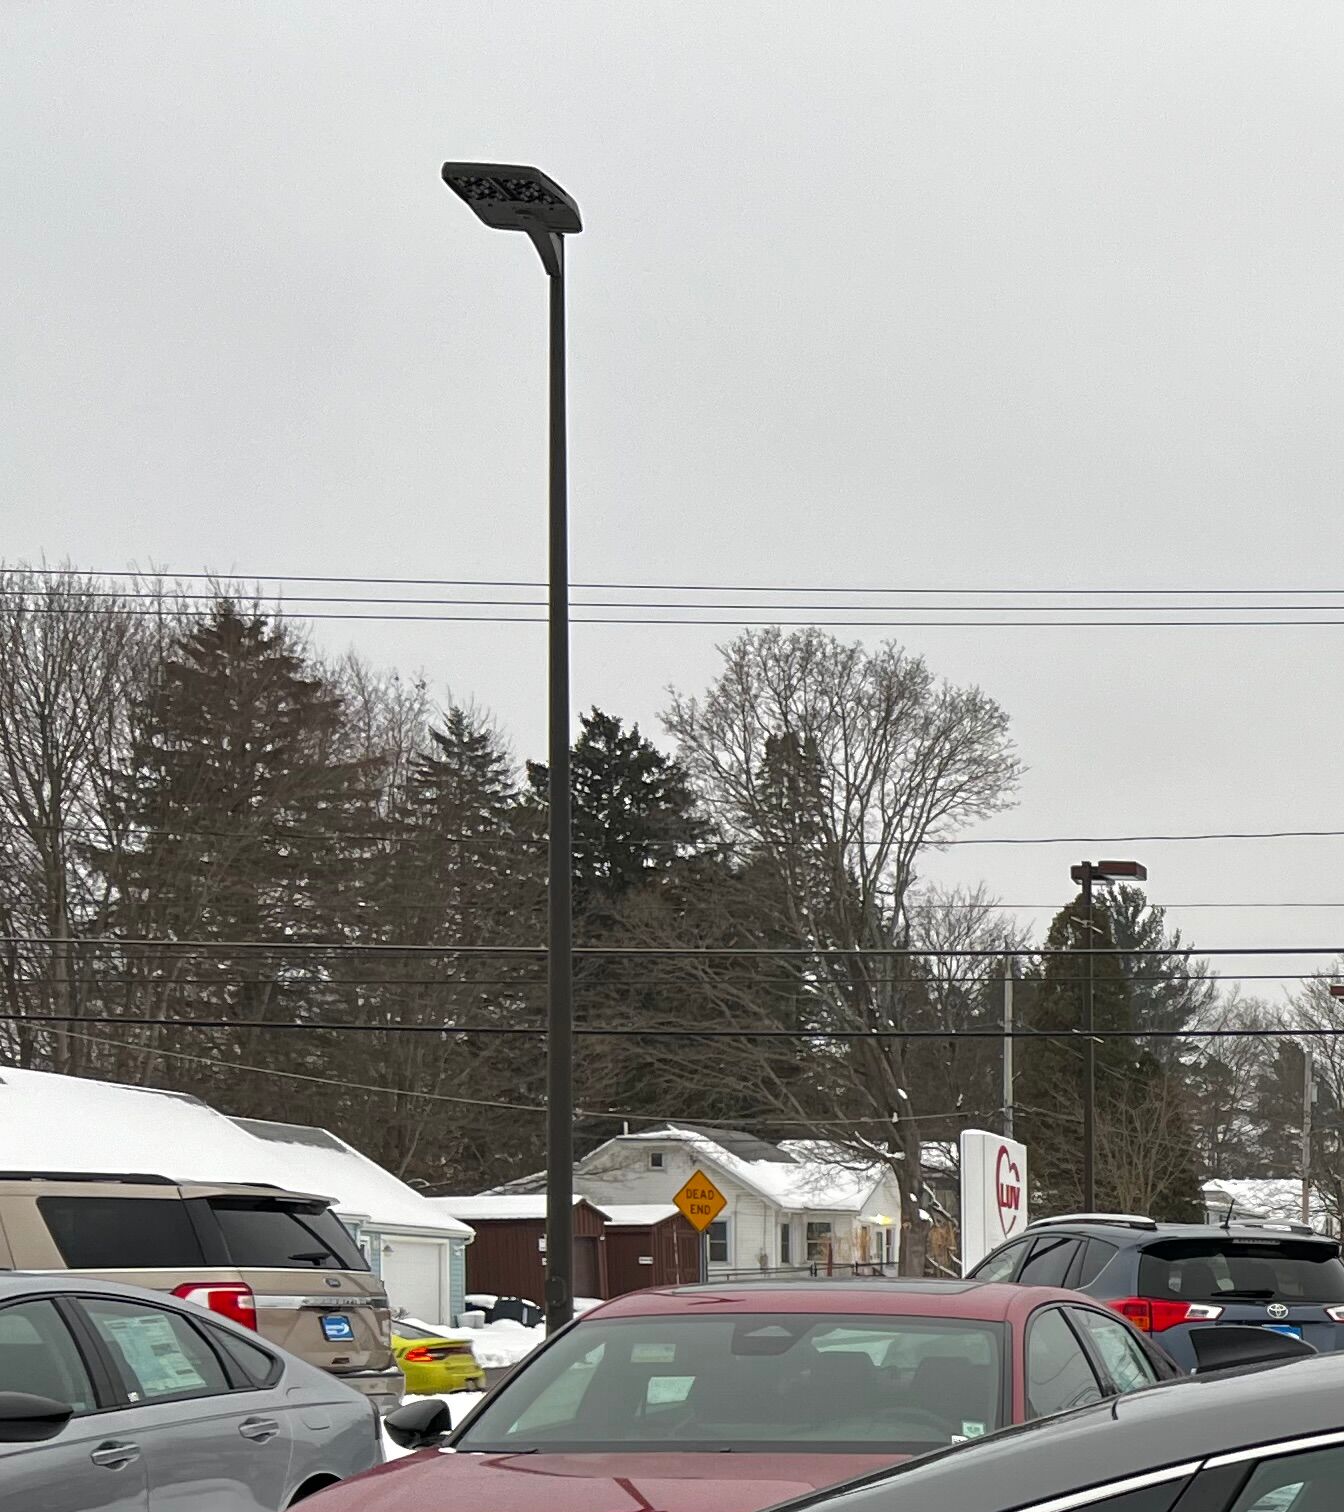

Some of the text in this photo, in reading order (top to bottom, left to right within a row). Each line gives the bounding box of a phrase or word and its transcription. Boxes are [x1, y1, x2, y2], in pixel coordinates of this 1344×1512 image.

[686, 1188, 714, 1200] DEAD
[999, 1182, 1021, 1210] LUV
[690, 1204, 711, 1215] END
